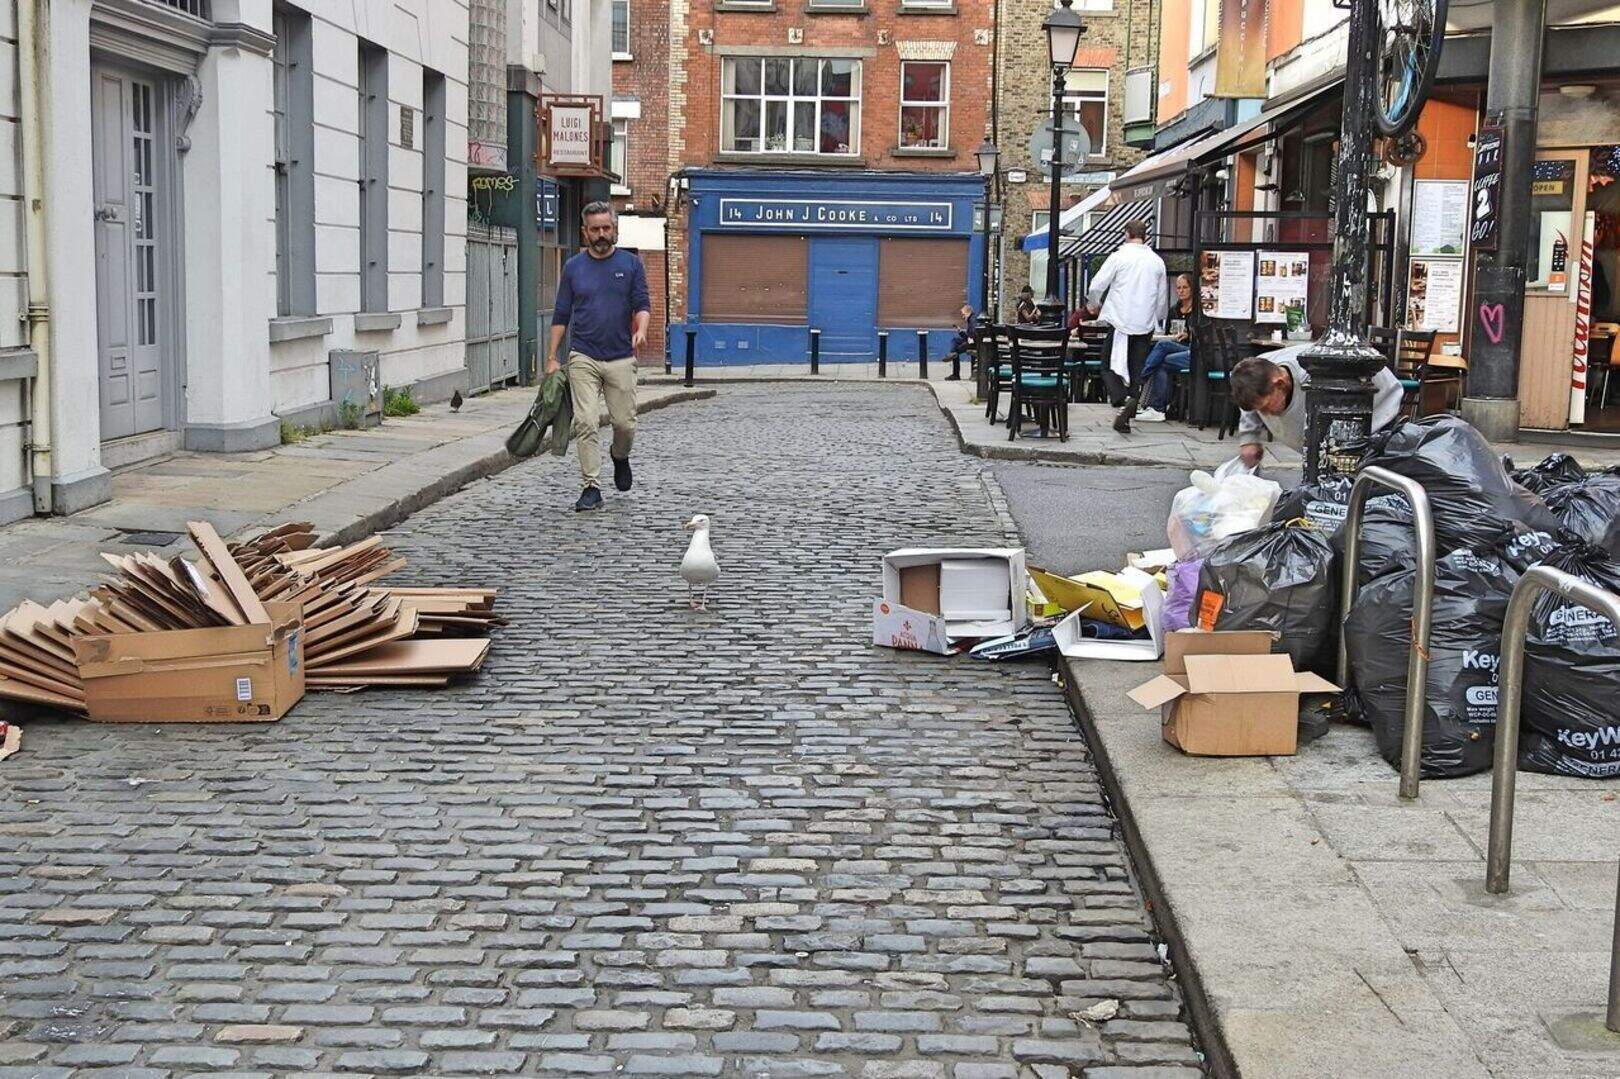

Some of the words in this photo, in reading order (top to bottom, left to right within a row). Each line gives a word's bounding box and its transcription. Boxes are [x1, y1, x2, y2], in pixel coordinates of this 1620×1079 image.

[561, 116, 581, 127] LUIGI
[553, 131, 588, 142] MALONES
[1533, 183, 1555, 192] OPEN
[1476, 188, 1493, 219] 2
[729, 207, 742, 219] 14
[756, 205, 794, 220] JOHN
[803, 206, 809, 220] J
[817, 206, 867, 221] COOKE
[930, 211, 943, 223] 14
[1471, 220, 1495, 242] GO!
[1334, 491, 1347, 501] 01
[1590, 749, 1605, 760] 01
